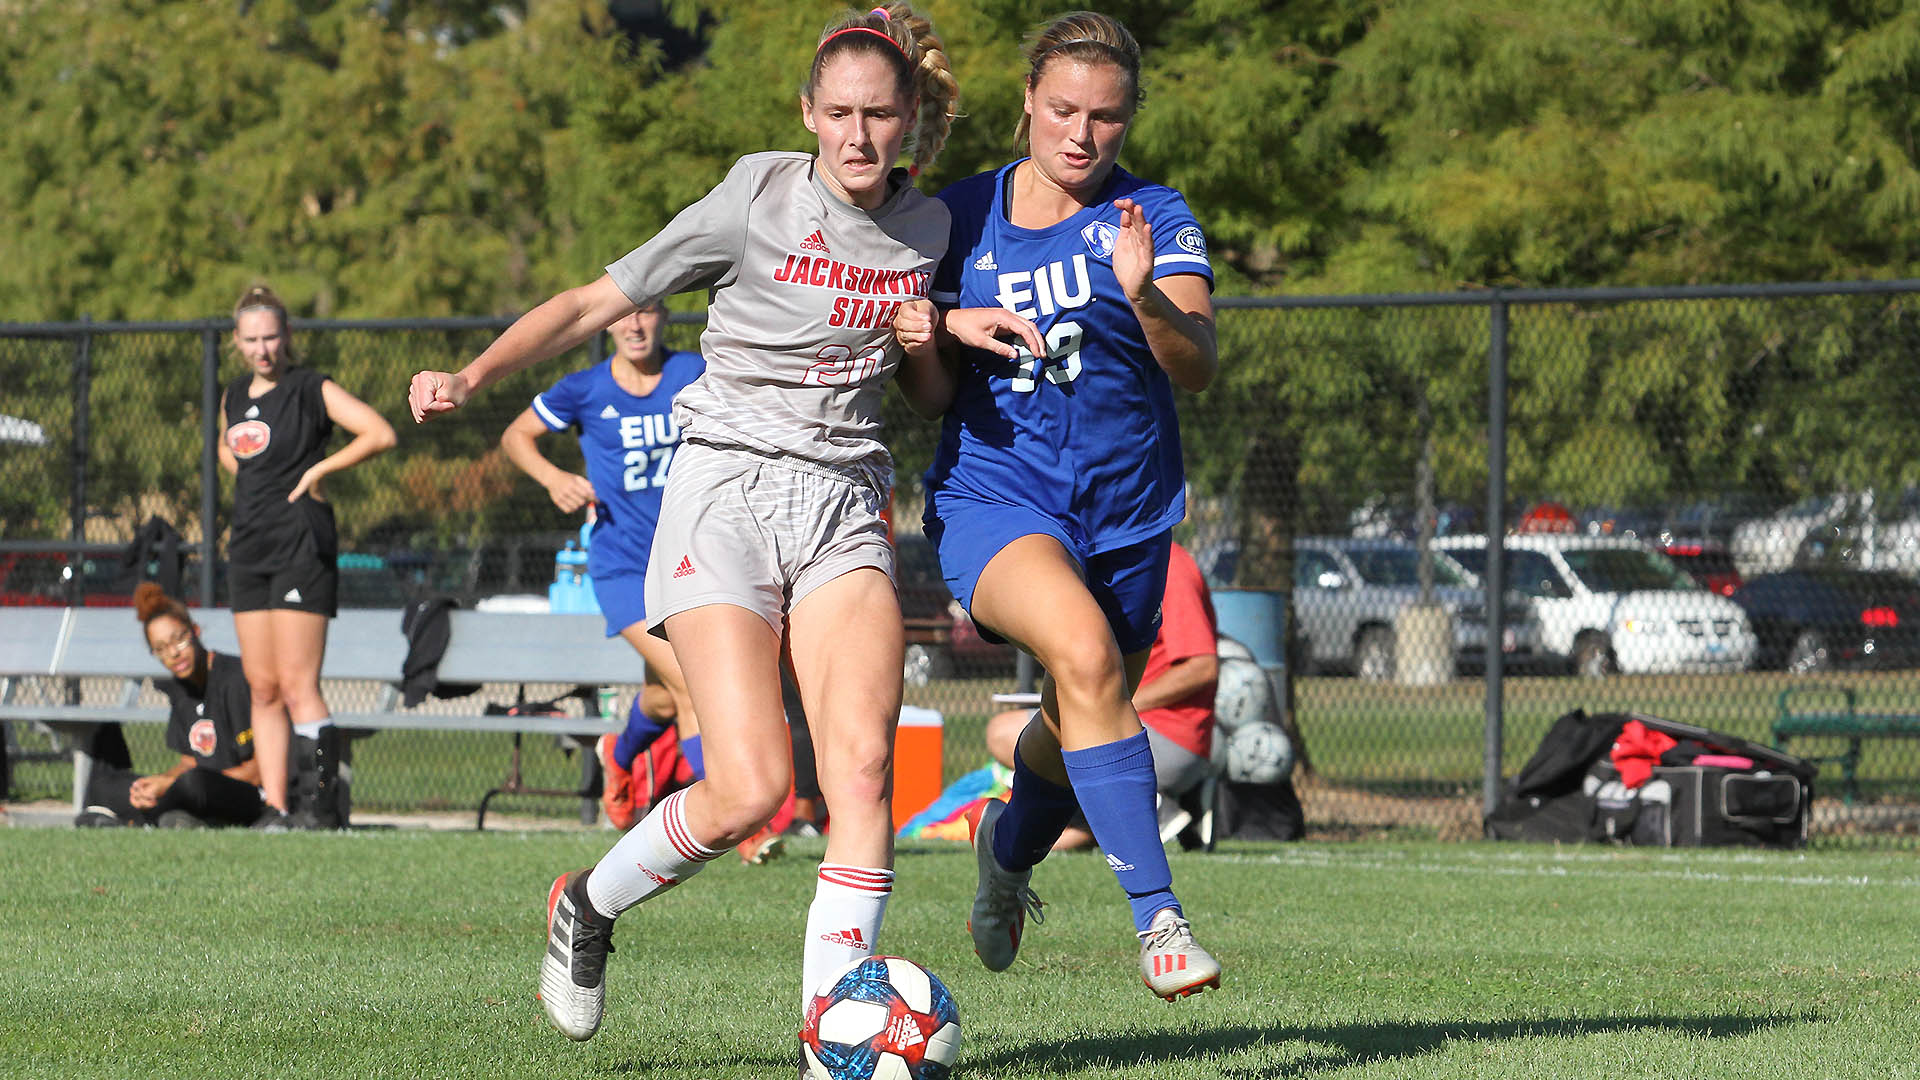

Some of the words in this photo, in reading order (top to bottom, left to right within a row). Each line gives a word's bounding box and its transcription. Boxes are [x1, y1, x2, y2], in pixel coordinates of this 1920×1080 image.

[799, 241, 831, 253] adidas
[994, 253, 1092, 321] EIU
[800, 343, 887, 389] 20
[618, 412, 680, 449] EIU
[623, 446, 674, 492] 27
[820, 933, 869, 950] adidas
